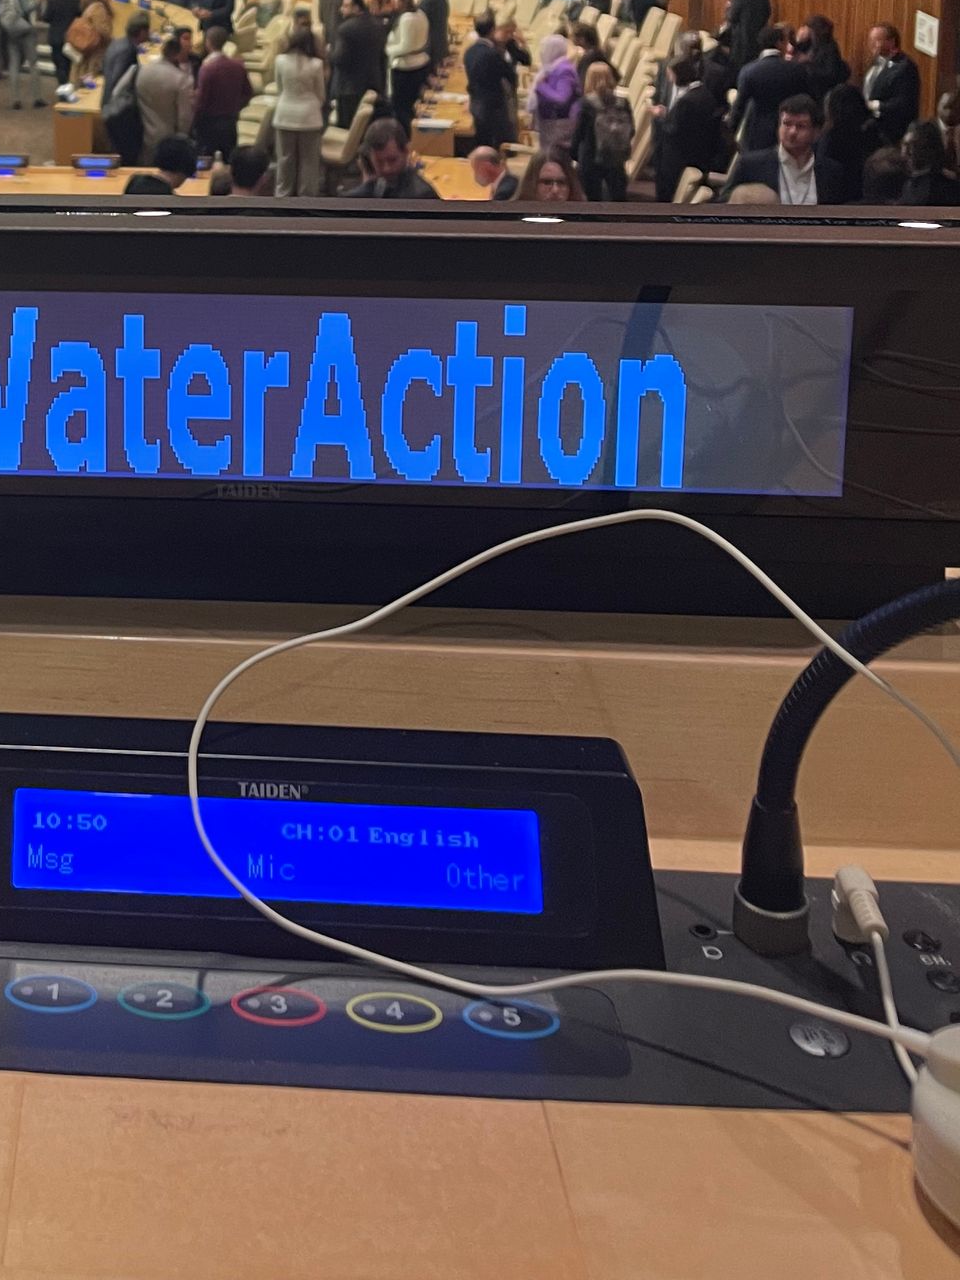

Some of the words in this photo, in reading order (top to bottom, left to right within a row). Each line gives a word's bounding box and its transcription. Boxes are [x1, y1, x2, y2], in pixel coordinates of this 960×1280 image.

[33, 811, 107, 831] 10:50
[281, 822, 359, 843] CH:01
[369, 827, 479, 848] English
[27, 843, 74, 875] Msg
[248, 853, 296, 880] Mic
[447, 862, 525, 891] Other
[47, 983, 60, 1000] 1
[156, 989, 173, 1008] 2
[270, 994, 288, 1014] 3
[385, 1001, 404, 1020] 4
[503, 1008, 522, 1026] 5
